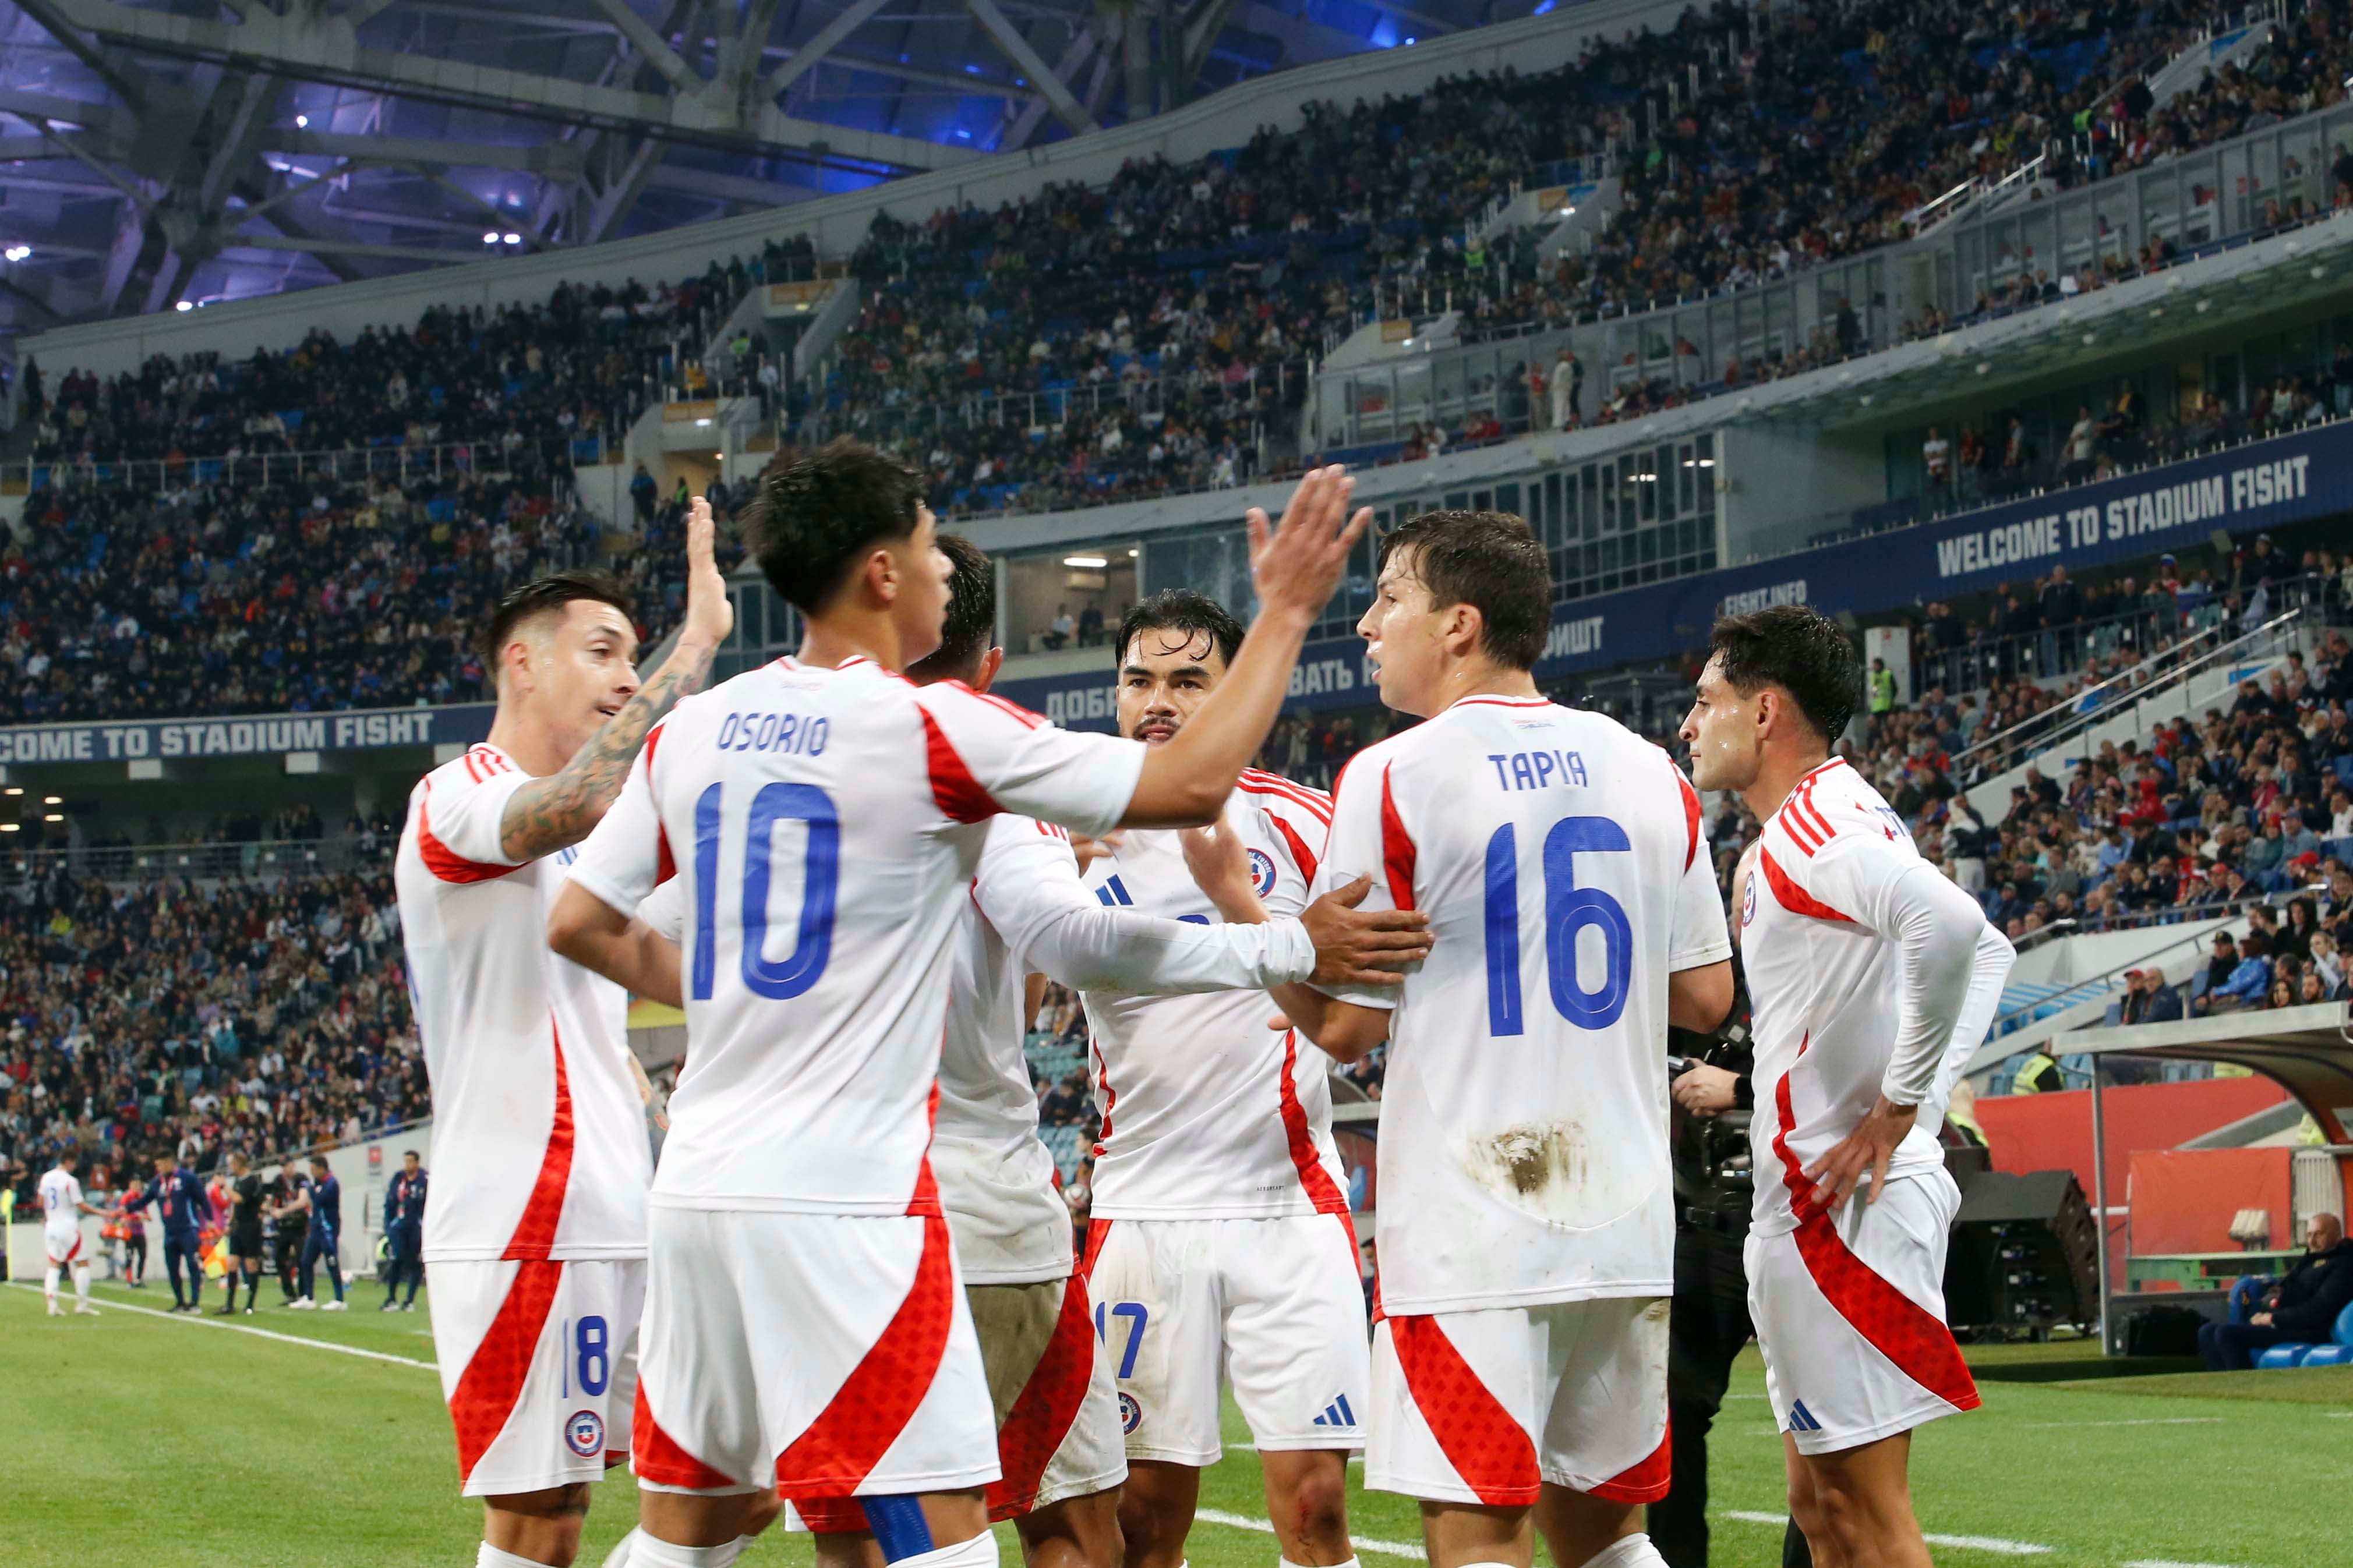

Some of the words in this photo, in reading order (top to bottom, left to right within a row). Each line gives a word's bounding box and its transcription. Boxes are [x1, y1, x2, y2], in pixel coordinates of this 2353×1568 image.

[1937, 514, 2061, 578] WELCOME
[2066, 505, 2100, 548] TO
[2107, 475, 2225, 540] STADIUM
[2231, 455, 2309, 512] FISHT
[102, 728, 149, 758] TO
[160, 718, 326, 756] STADIUM
[335, 712, 433, 747] FISHT
[717, 712, 829, 757] OSORIO
[1487, 749, 1588, 791] TAPIA
[691, 781, 840, 1000] 10
[1485, 816, 1633, 1038] 16
